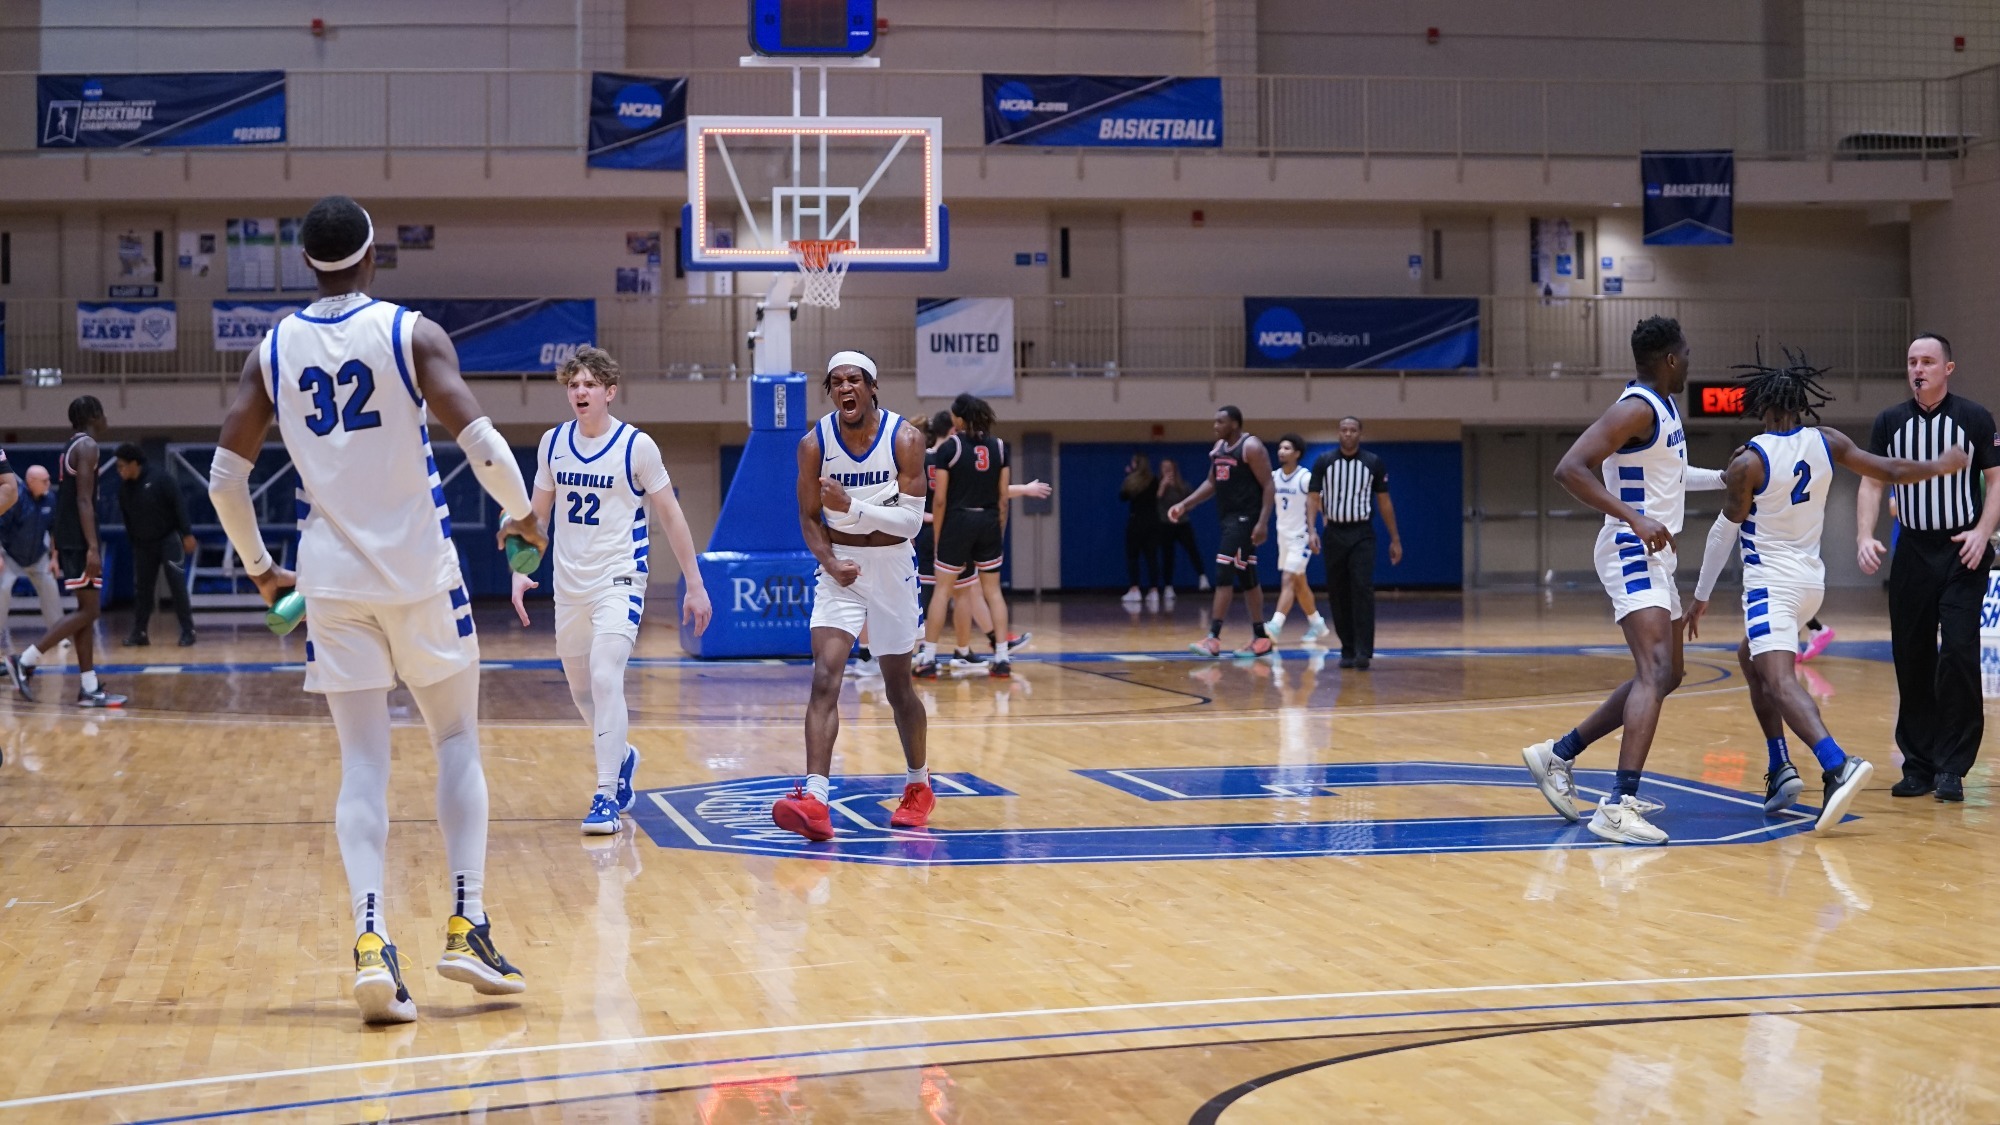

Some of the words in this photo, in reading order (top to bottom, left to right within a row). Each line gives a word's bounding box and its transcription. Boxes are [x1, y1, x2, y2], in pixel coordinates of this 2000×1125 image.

[81, 107, 154, 120] BASKETBALL
[618, 103, 663, 118] NCAA
[999, 99, 1069, 112] NCAA.com
[1098, 118, 1217, 140] BASKETBALL
[1662, 183, 1730, 197] BASKETBALL
[82, 324, 136, 339] EAST
[218, 324, 273, 338] EAST
[1258, 331, 1303, 346] NCAA
[1307, 331, 1360, 346] Division
[1362, 332, 1371, 346] II
[930, 333, 999, 353] UNITED
[298, 358, 382, 437] 32
[776, 385, 786, 426] PORTER
[974, 445, 990, 471] 3
[556, 471, 615, 489] GLENVILLE
[1790, 459, 1812, 506] 2
[566, 491, 601, 526] 22
[730, 577, 816, 613] RATLI
[734, 620, 809, 629] INSURANCE
